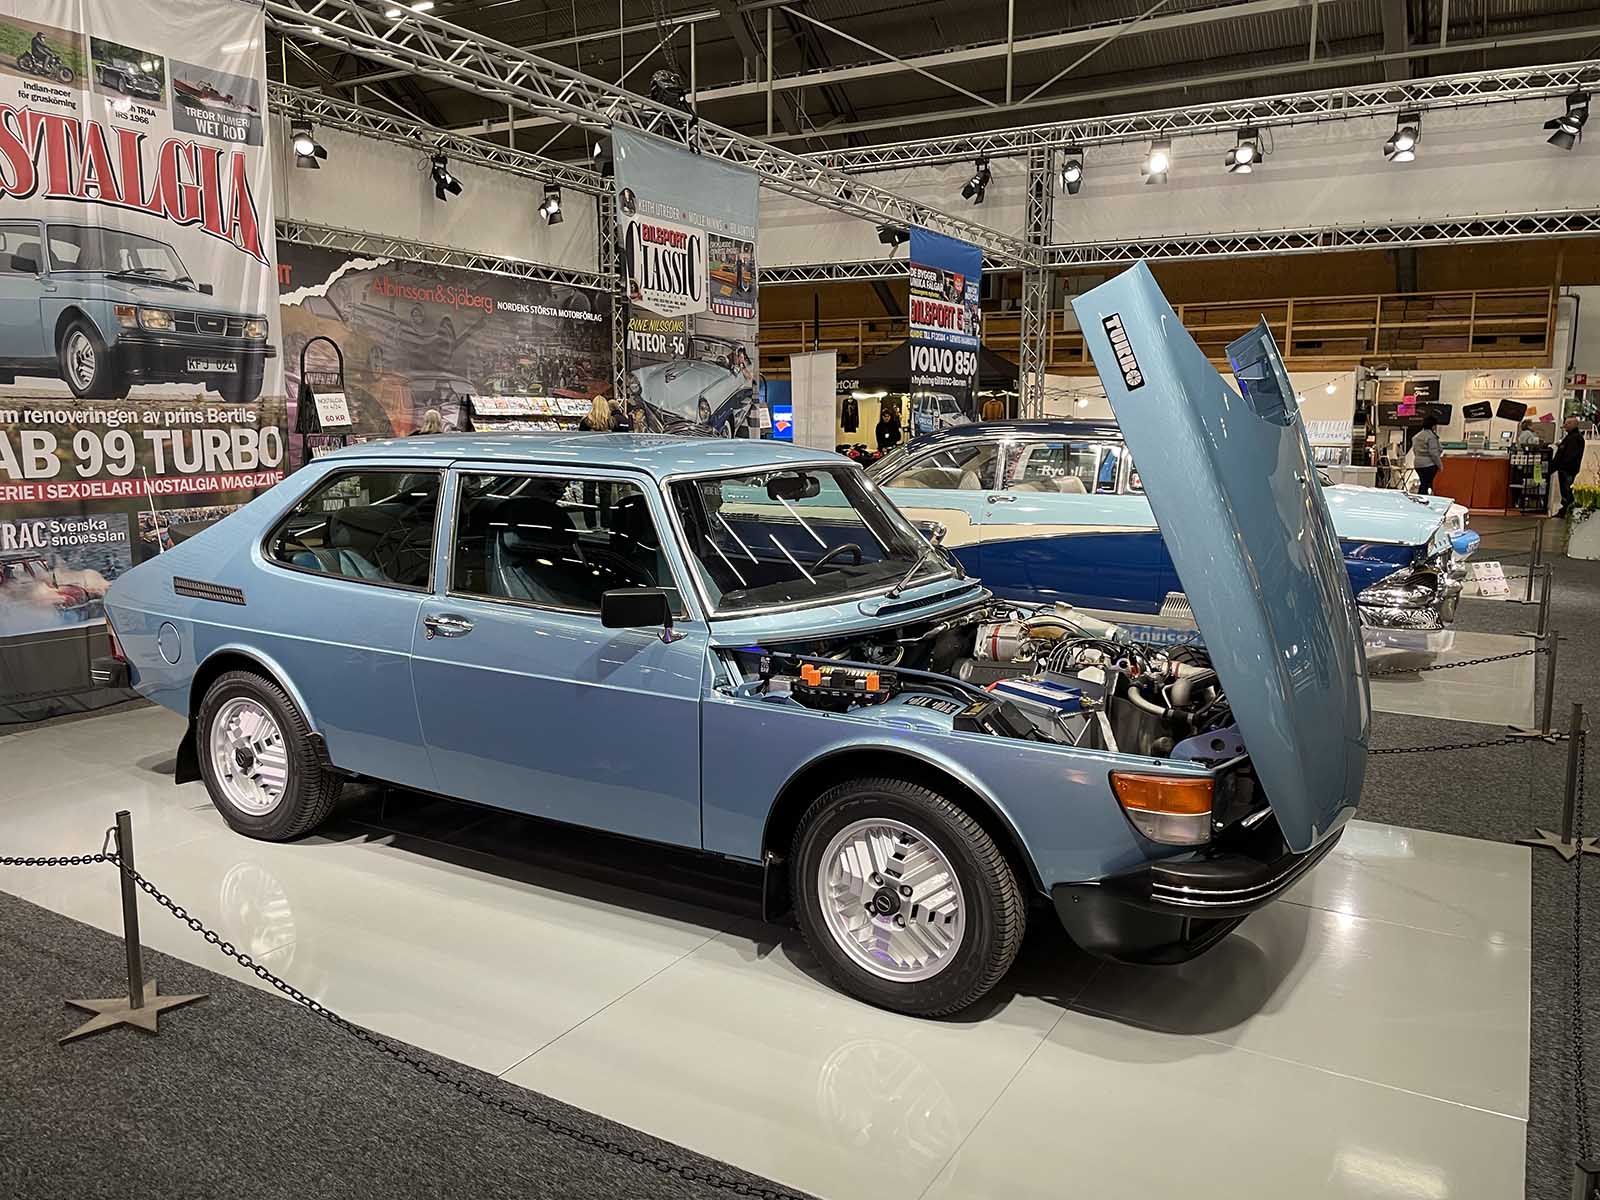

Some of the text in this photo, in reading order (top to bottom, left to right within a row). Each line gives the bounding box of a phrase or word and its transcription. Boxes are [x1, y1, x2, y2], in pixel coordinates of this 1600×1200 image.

[24, 81, 71, 97] Indian-racer
[18, 90, 76, 110] för gruskörning
[130, 114, 149, 124] 1966
[137, 106, 156, 117] TR4A
[185, 106, 215, 121] TREOR
[195, 118, 246, 141] WET ROD
[642, 223, 688, 249] BILSPORT
[626, 220, 701, 301] CLASSIC
[497, 301, 602, 322] NORDENS STÖRSTA MOTORFÖRLAG
[911, 299, 956, 329] BILSPORT
[649, 319, 684, 332] NILSSONS
[1105, 314, 1142, 386] TURBO
[188, 359, 235, 371] KFJ 024
[910, 345, 977, 376] VOLVO 850
[24, 408, 138, 428] renoveringen
[143, 410, 160, 423] av
[165, 409, 204, 427] prins
[208, 408, 256, 423] Bertils
[72, 429, 135, 478] 99
[144, 426, 283, 475] TURBO
[38, 485, 43, 499] I
[144, 477, 218, 495] NOSTALGIA
[50, 519, 107, 533] Svenska
[52, 531, 125, 546] snövesslan
